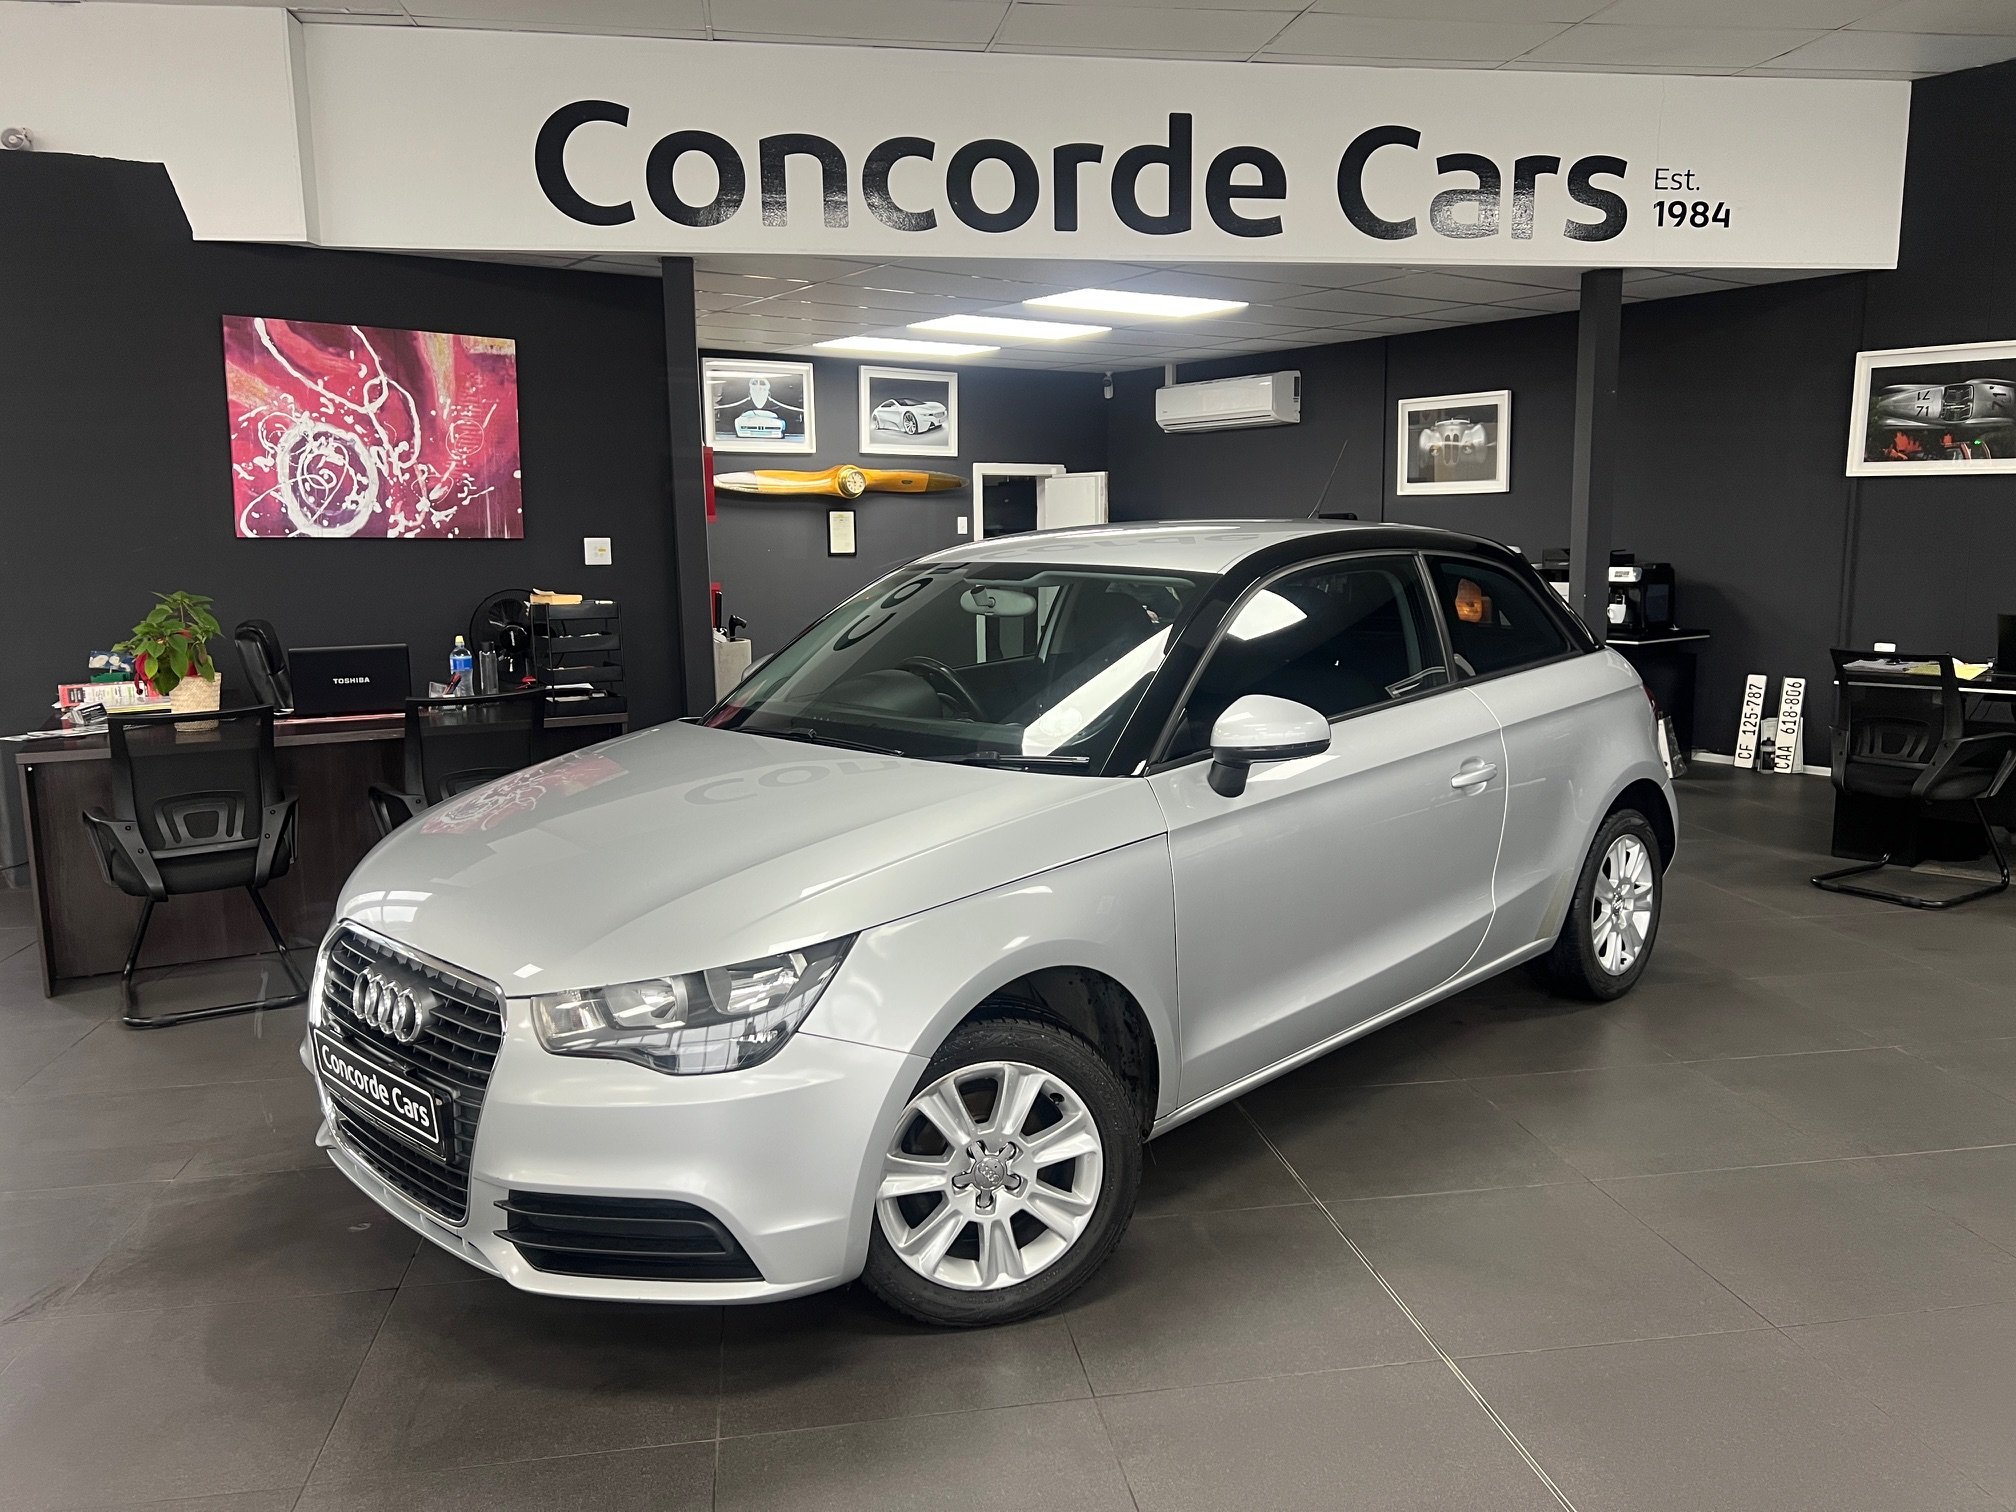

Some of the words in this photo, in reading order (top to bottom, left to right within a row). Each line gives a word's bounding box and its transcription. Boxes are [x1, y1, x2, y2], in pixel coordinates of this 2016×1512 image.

[534, 99, 1287, 238] Concorde
[1337, 124, 1629, 242] Cars
[1654, 167, 1701, 191] Est.
[1653, 200, 1731, 228] 1984
[1916, 405, 1930, 417] 71
[332, 676, 370, 685] TOSHIBA
[1742, 683, 1762, 736] 125-787
[1738, 743, 1753, 760] CF
[1774, 745, 1793, 770] CAA
[321, 1044, 390, 1106] Concorde
[392, 1087, 430, 1127] Cars
